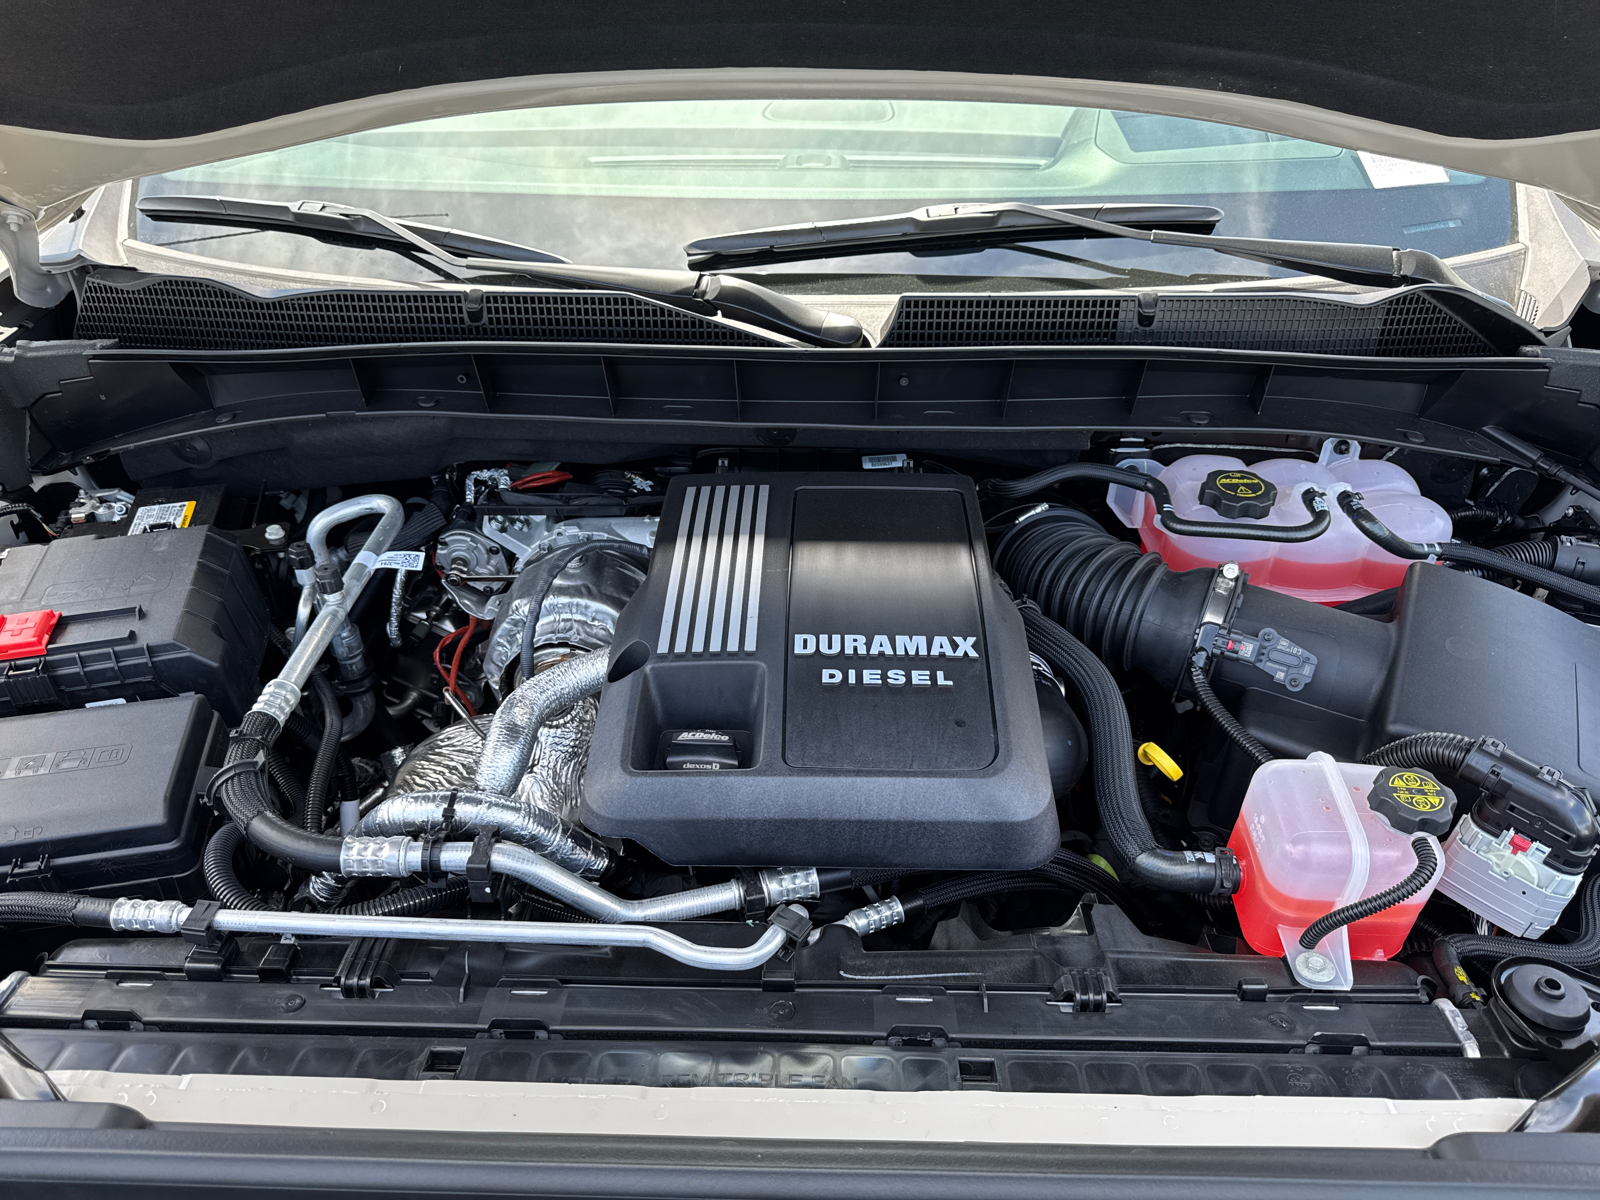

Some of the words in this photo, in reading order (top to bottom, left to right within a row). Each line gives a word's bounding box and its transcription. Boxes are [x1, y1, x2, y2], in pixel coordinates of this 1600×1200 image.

[794, 634, 979, 659] DURAMAX
[821, 668, 954, 687] DIESEL
[677, 732, 730, 741] ACDelco
[718, 1073, 803, 1088] TRIPLE
[811, 1074, 858, 1089] FAN
